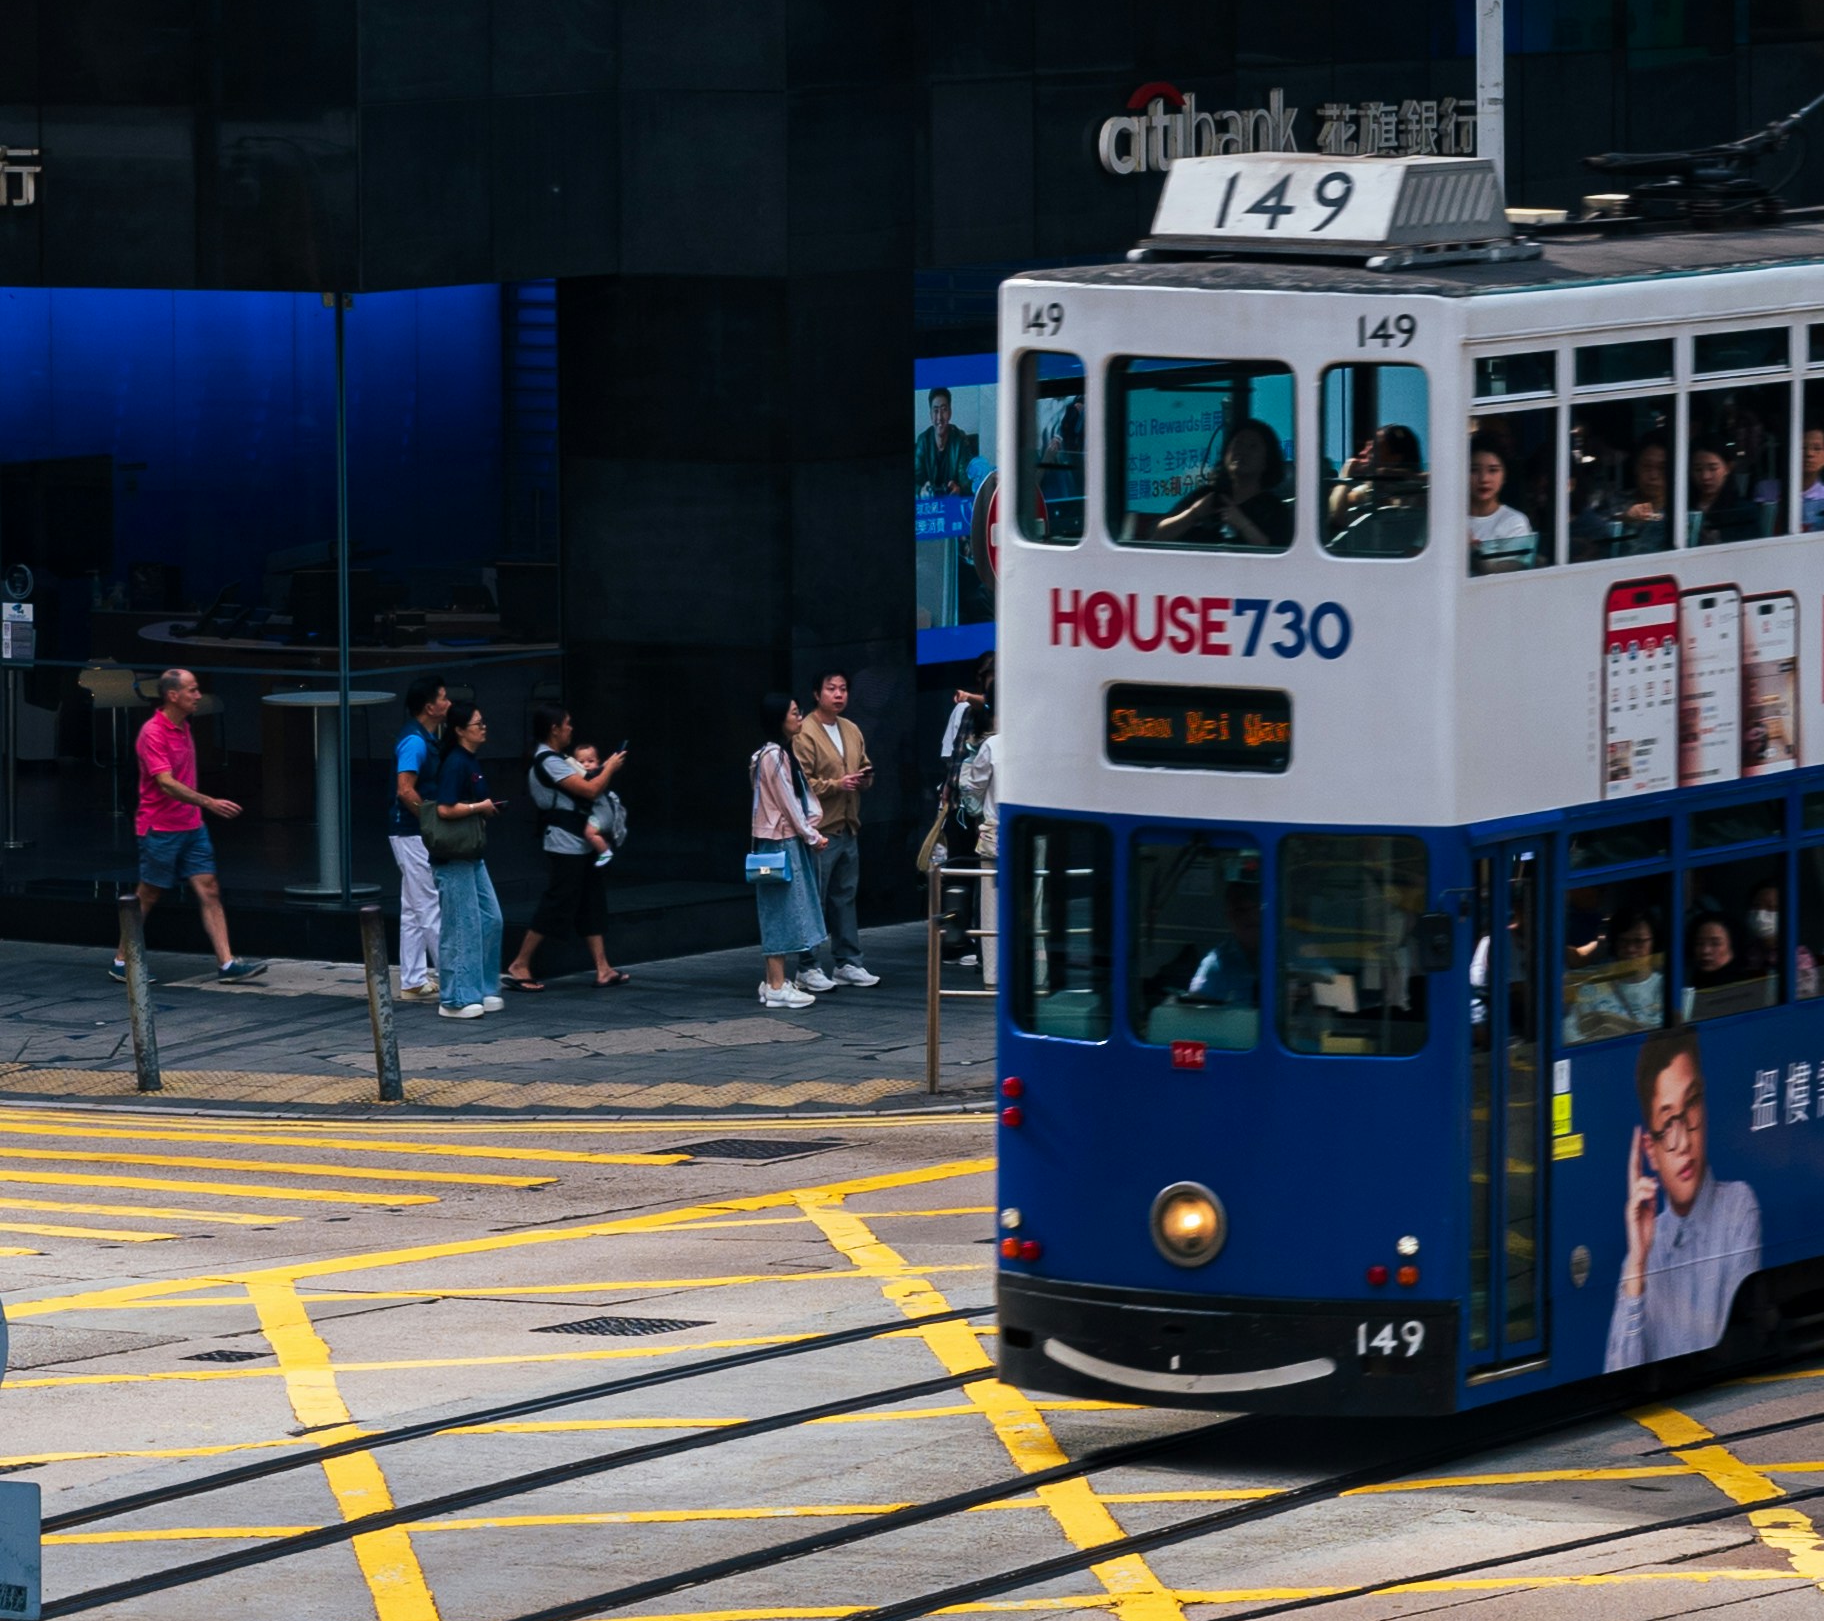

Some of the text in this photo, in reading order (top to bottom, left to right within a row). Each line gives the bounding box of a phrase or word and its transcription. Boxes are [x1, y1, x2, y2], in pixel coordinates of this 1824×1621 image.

[1100, 82, 1299, 173] citibank
[1315, 96, 1478, 156] 花旗銀行
[1215, 170, 1357, 234] 149
[1020, 301, 1065, 338] 149
[1356, 313, 1418, 349] 149
[1127, 418, 1148, 438] Citi
[1050, 587, 1352, 660] HOUSE730
[1355, 1318, 1426, 1358] 149
